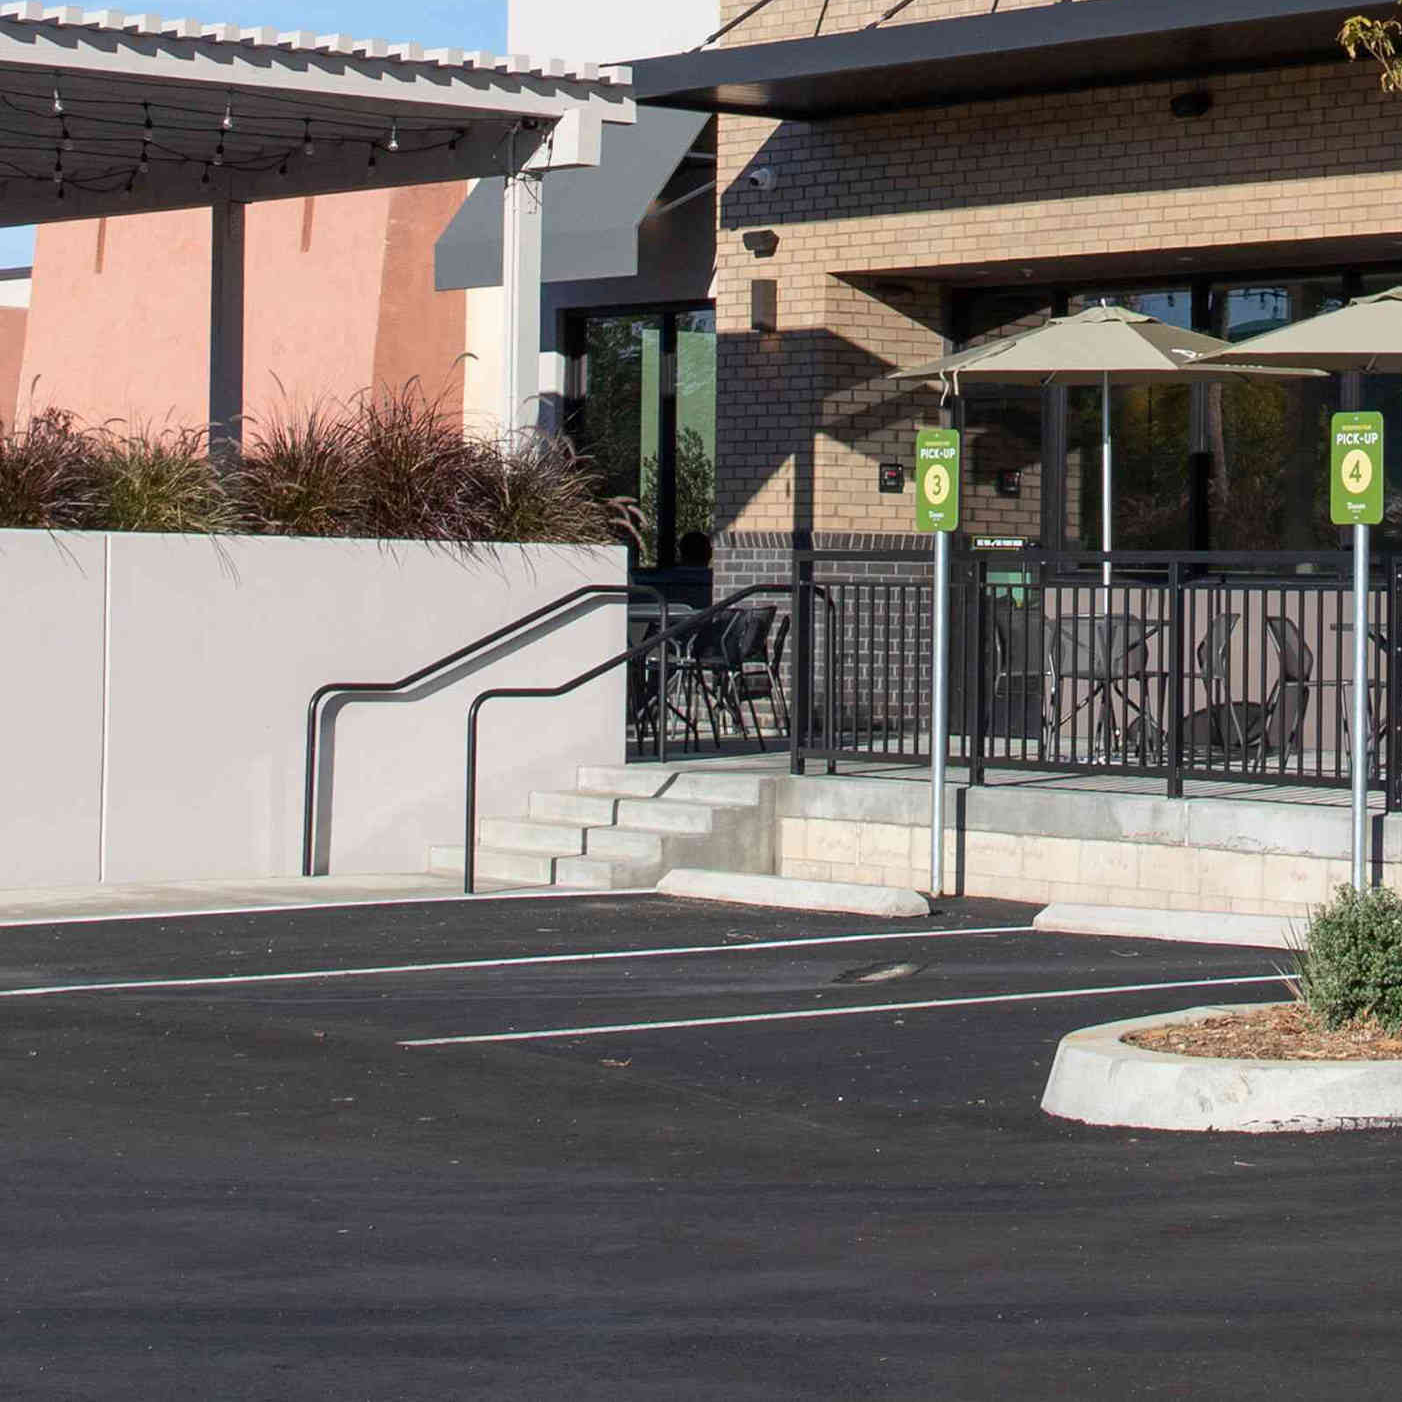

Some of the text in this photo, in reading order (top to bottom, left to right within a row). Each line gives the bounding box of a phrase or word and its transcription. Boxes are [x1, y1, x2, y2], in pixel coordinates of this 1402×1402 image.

[1335, 431, 1378, 445] PICK-UP
[920, 446, 957, 459] PICK-UP
[1348, 458, 1362, 483] 4
[932, 474, 943, 496] 3
